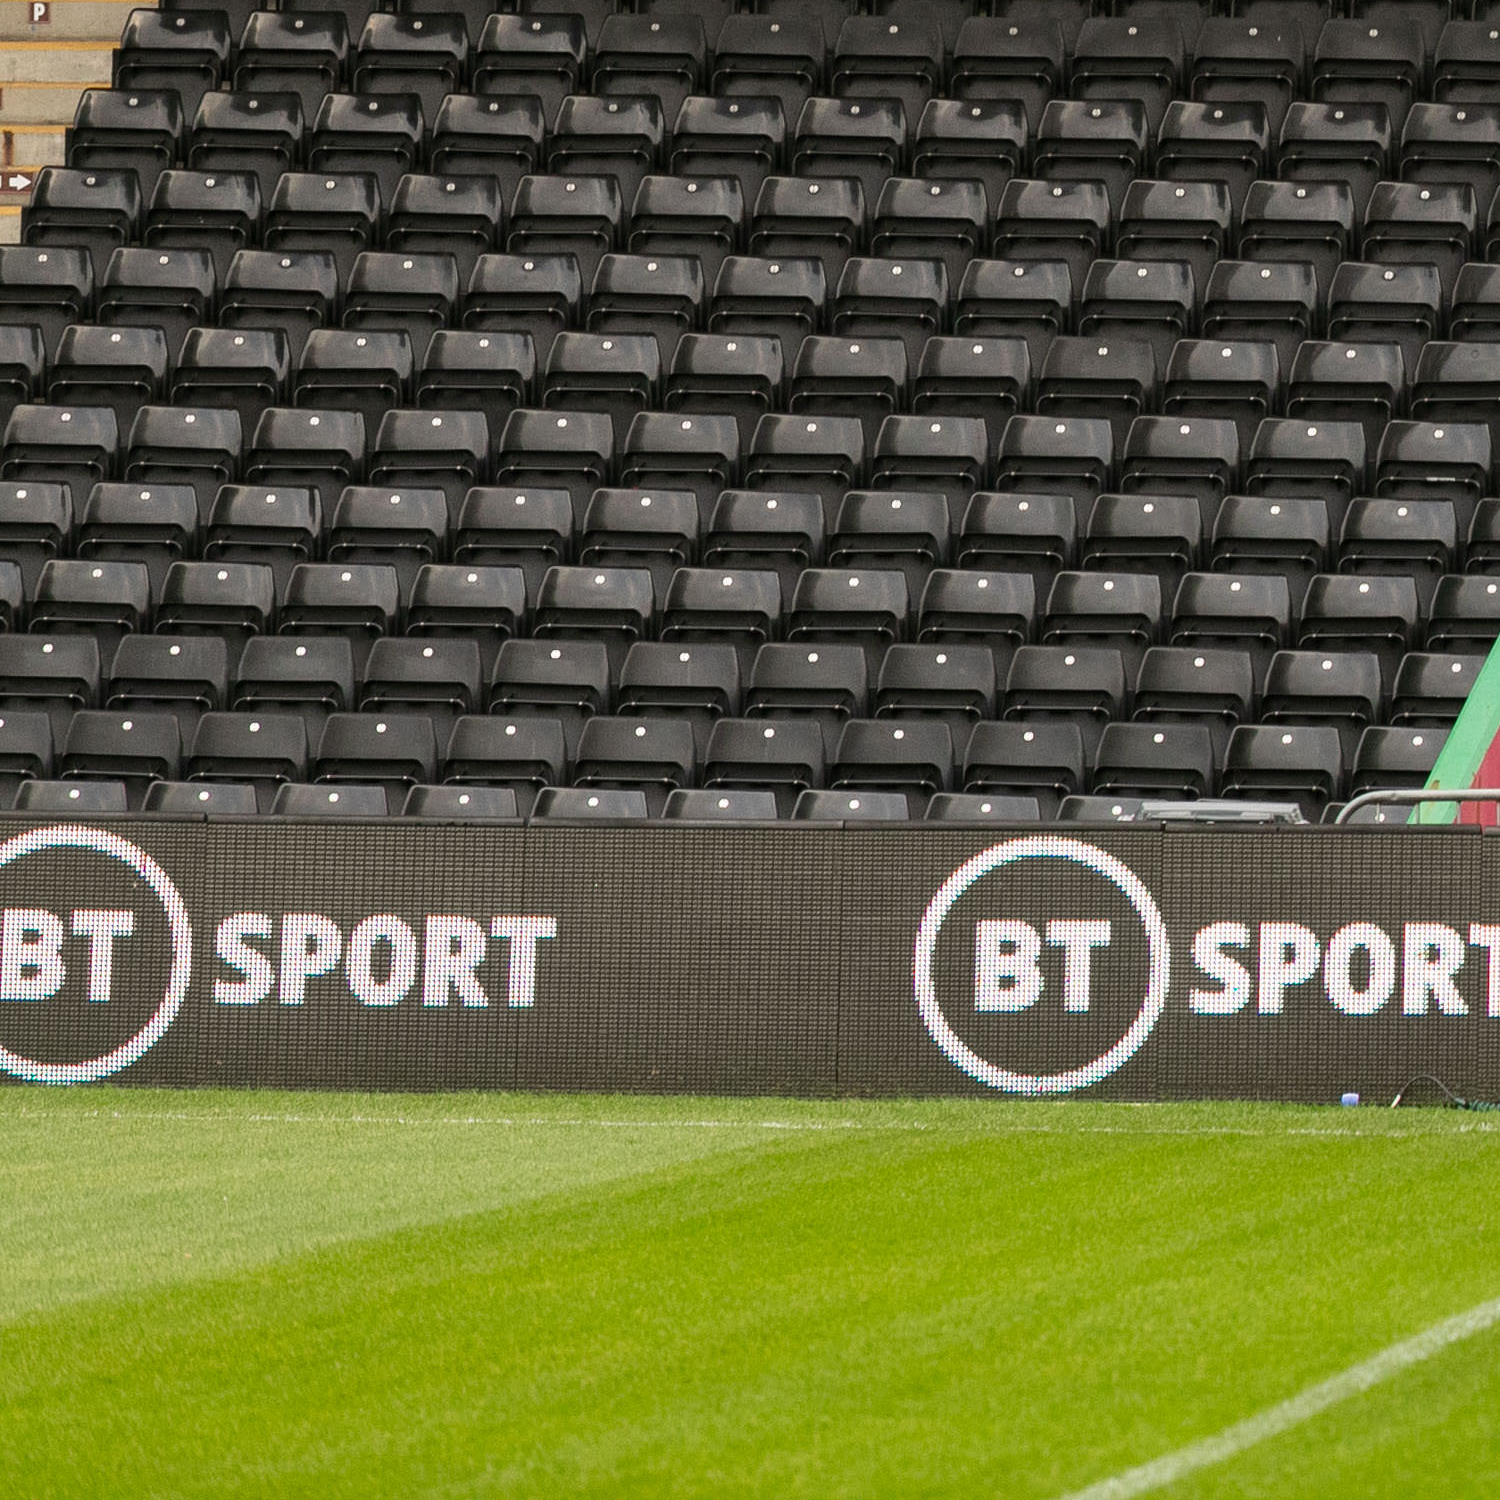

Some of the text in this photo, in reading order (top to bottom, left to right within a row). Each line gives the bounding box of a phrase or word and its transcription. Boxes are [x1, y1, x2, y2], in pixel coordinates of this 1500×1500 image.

[33, 2, 46, 22] P
[1, 908, 558, 1008] BT SPORT
[973, 918, 1112, 1013] BT
